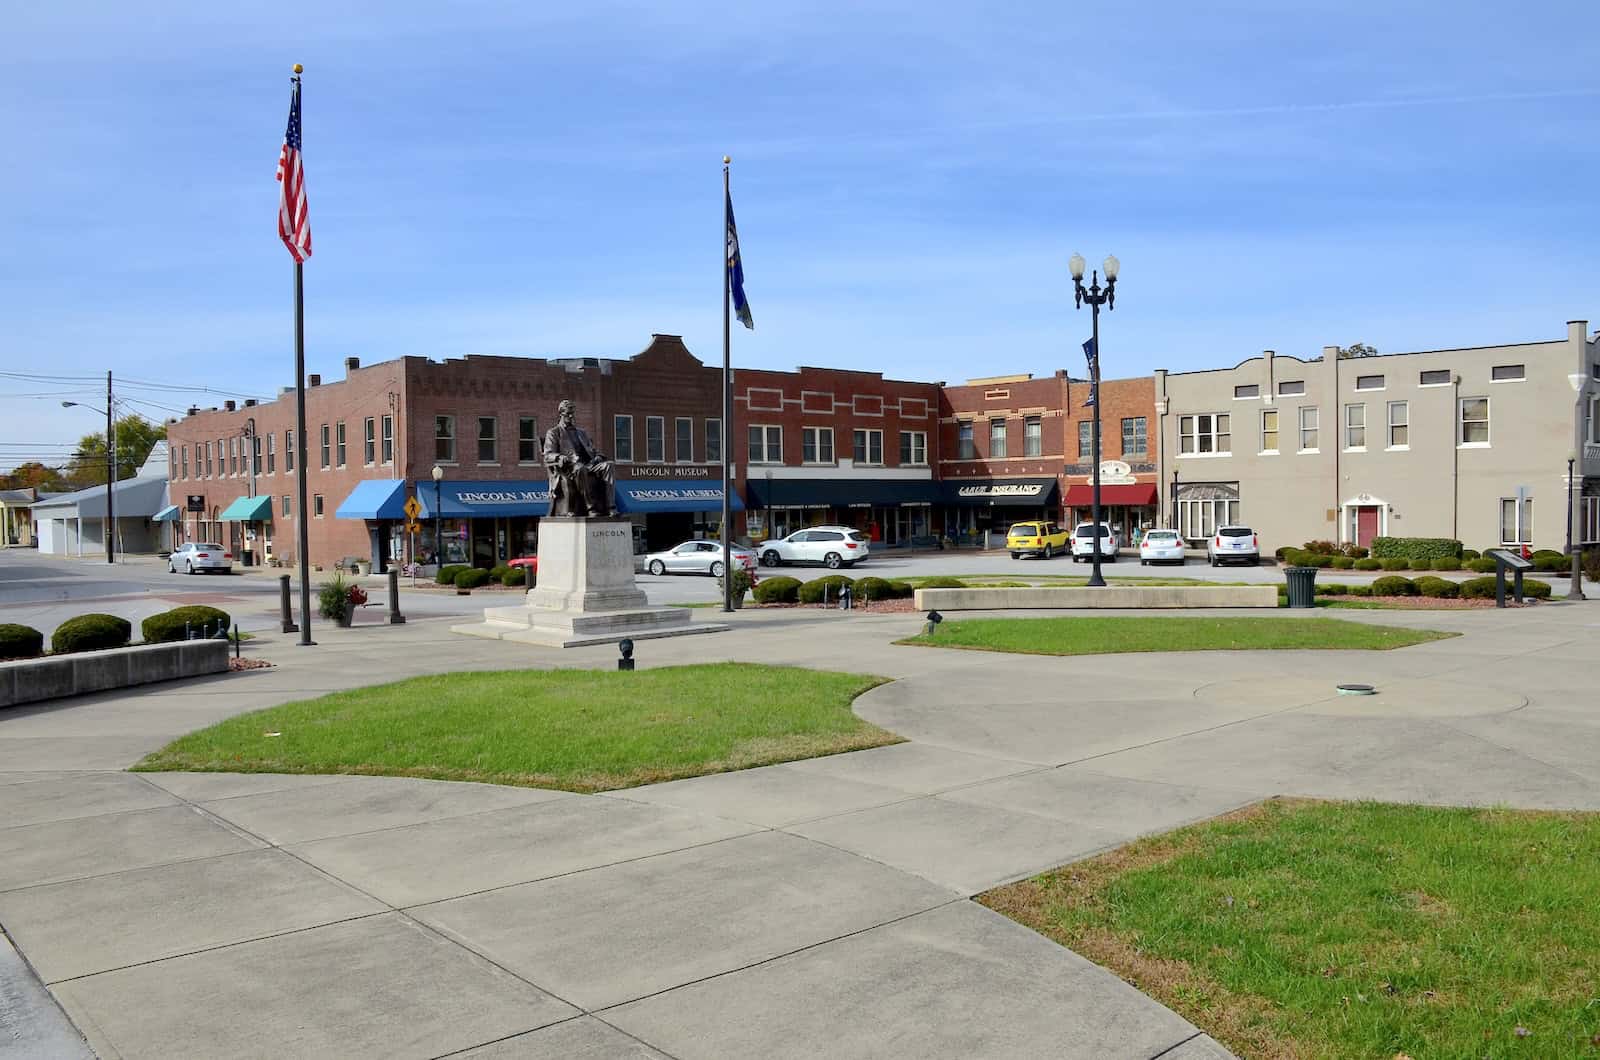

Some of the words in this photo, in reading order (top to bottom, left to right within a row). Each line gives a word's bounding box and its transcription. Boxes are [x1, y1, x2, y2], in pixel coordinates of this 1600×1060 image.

[631, 467, 670, 476] LINCOLN
[674, 467, 709, 476] MUSEUM
[628, 490, 680, 499] LINCOLN
[989, 485, 1043, 496] INSURANCE
[456, 491, 517, 501] LINCOLN
[520, 491, 550, 501] MUS
